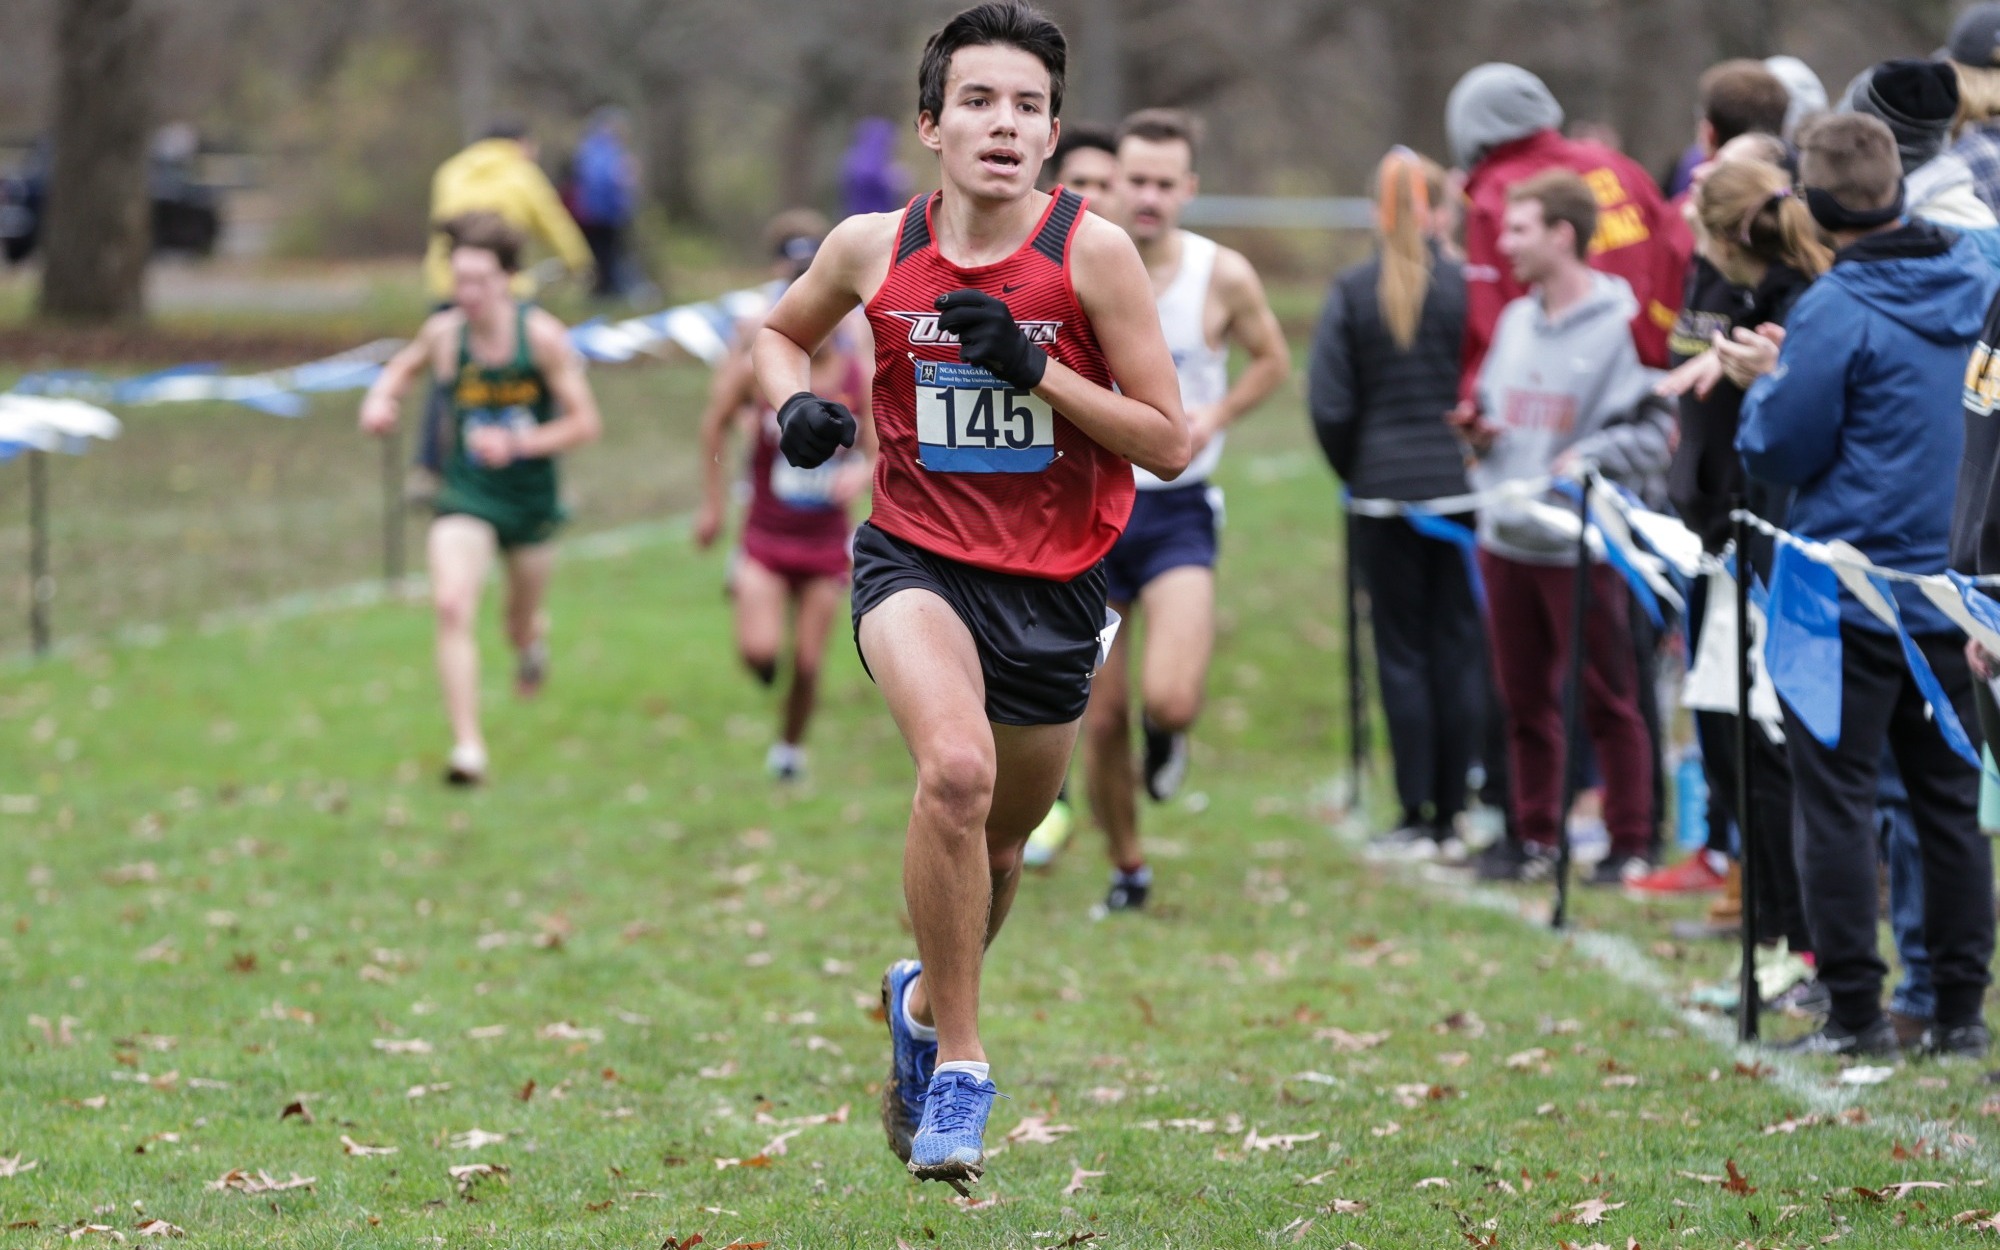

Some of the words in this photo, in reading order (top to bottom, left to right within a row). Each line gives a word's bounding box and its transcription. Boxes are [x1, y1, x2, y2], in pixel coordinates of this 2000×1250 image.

[939, 366, 957, 375] NCAA
[958, 368, 988, 376] NIAGARA
[935, 385, 1034, 450] 145
